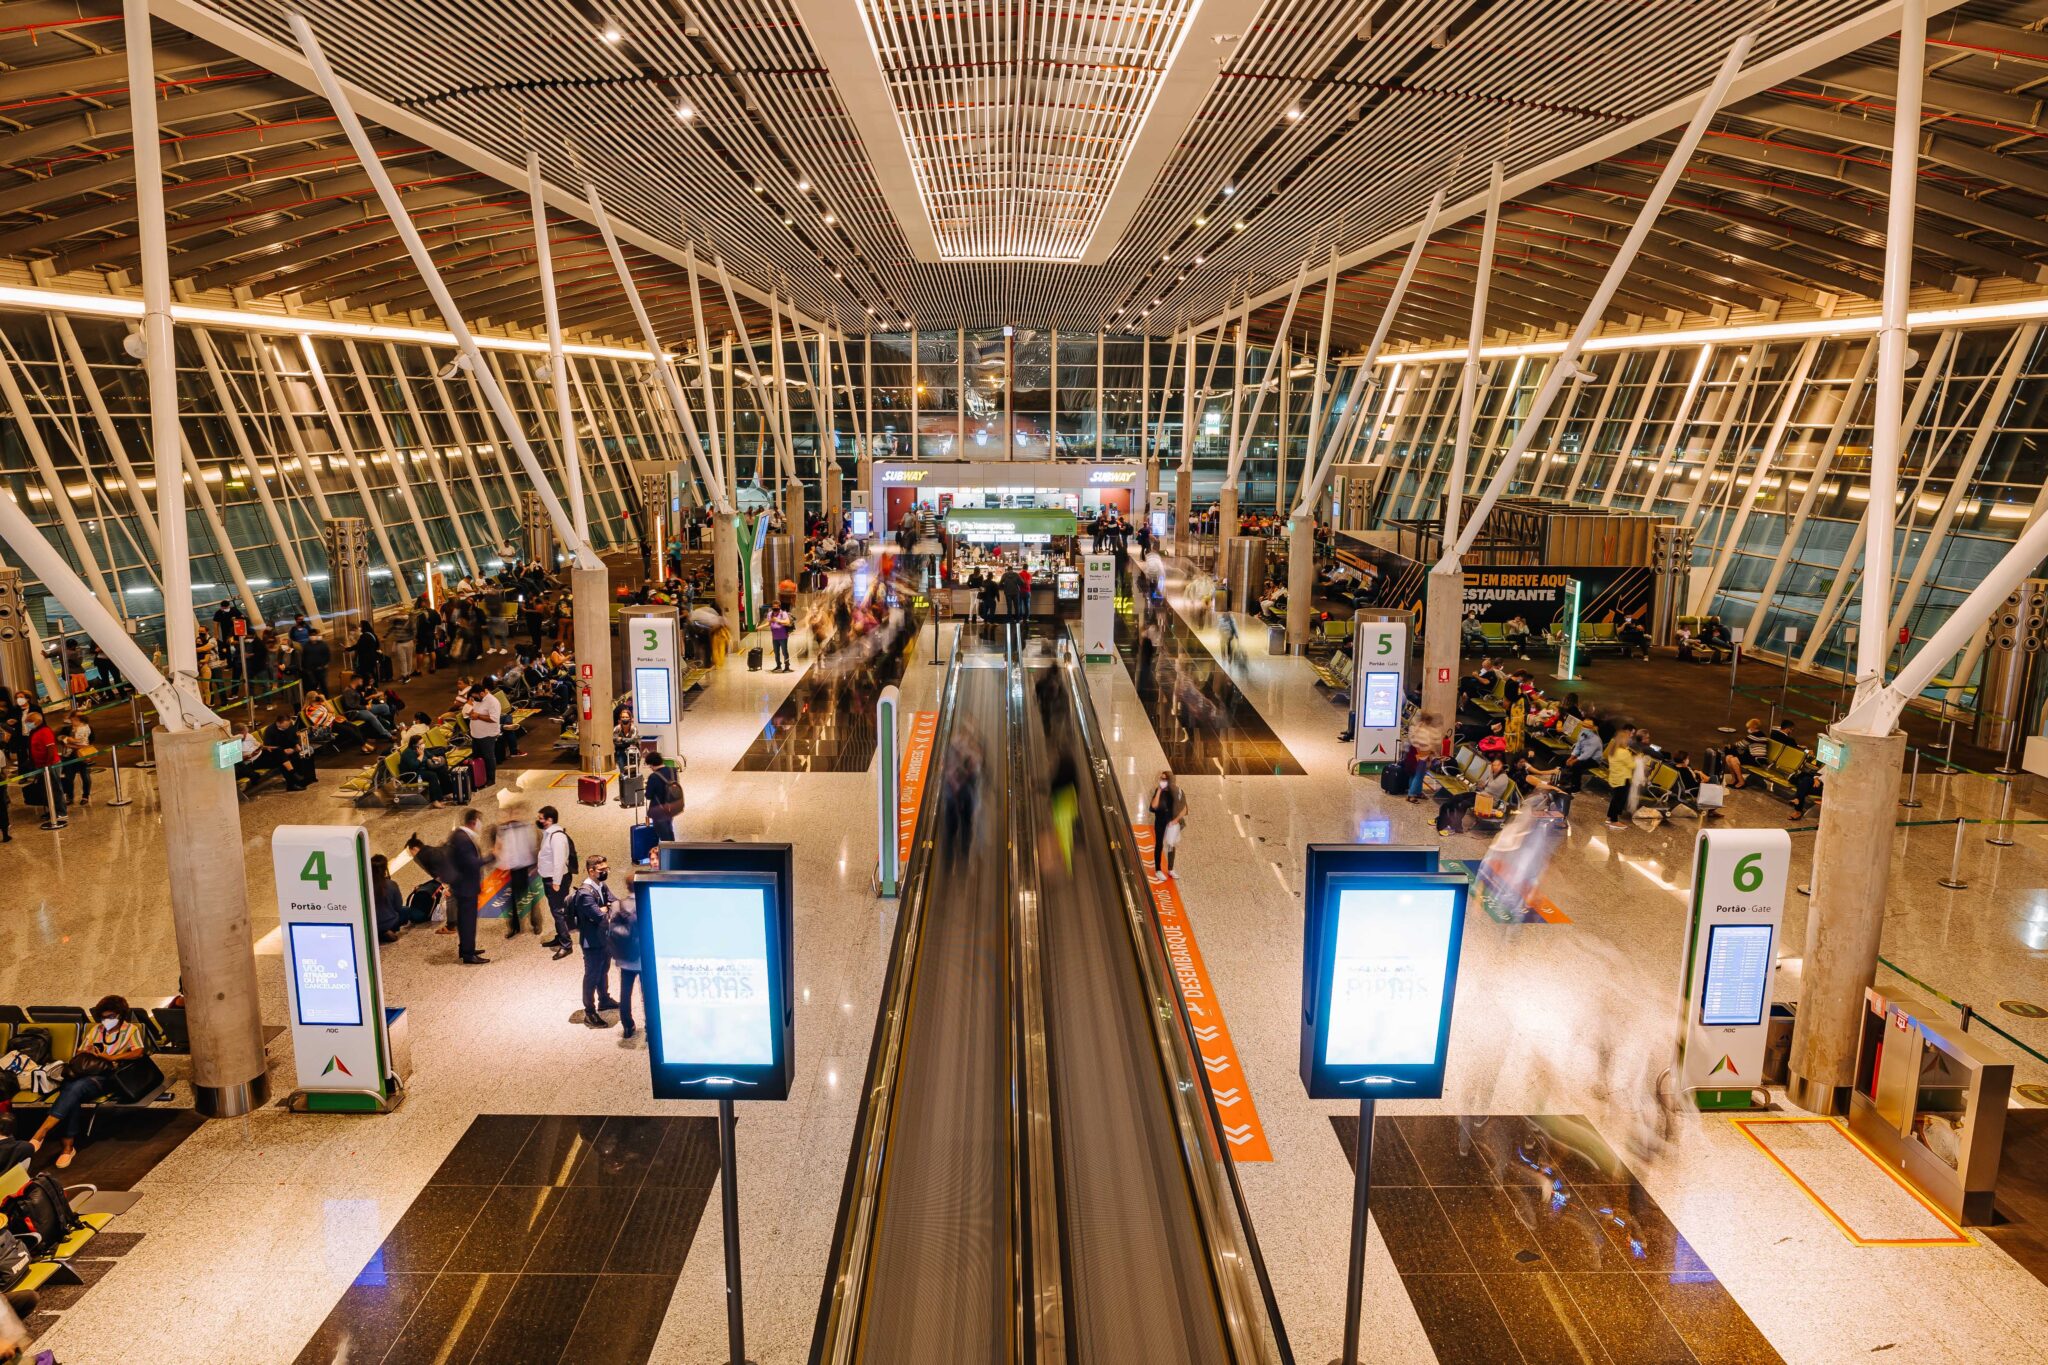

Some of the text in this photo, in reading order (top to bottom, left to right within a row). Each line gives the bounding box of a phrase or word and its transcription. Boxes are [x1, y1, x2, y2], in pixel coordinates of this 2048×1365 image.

[882, 471, 928, 481] SUBWAY
[1090, 471, 1136, 482] SUBWAY
[858, 495, 863, 504] 1
[1155, 496, 1163, 506] 2
[1481, 574, 1568, 588] EM BREVE AQU
[643, 629, 659, 651] 3
[1376, 633, 1393, 655] 5
[300, 851, 332, 891] 4
[1733, 852, 1764, 892] 6
[291, 902, 348, 911] Portão Gate
[1716, 904, 1772, 913] Portão Gate
[1156, 890, 1204, 997] Arrivals DESEMBARQUE
[12, 1255, 30, 1274] PUMA
